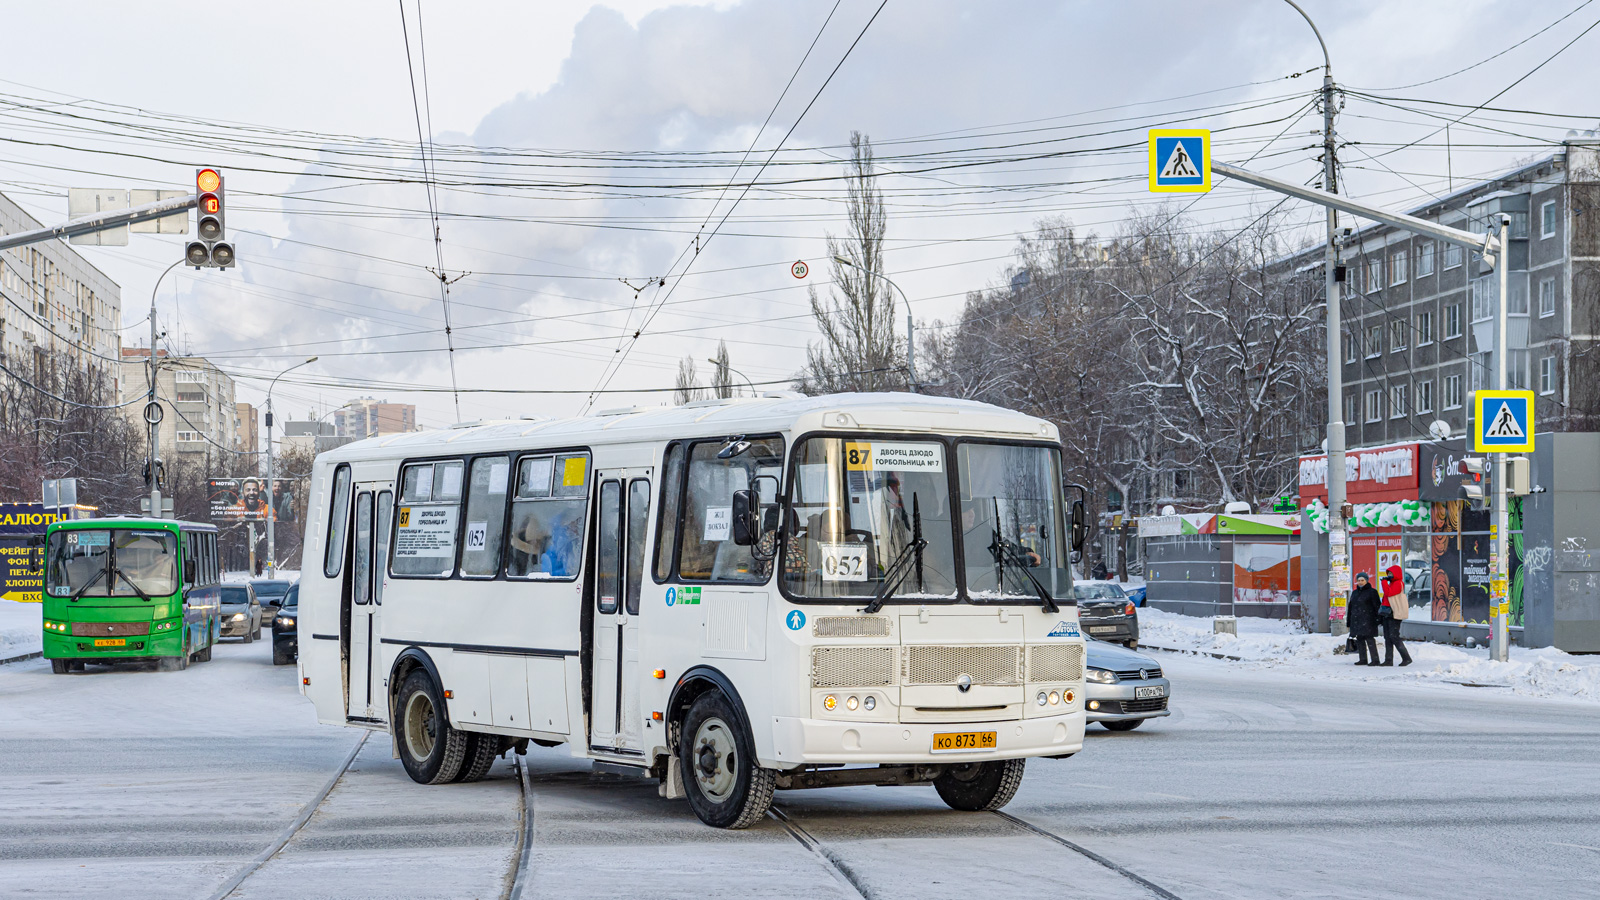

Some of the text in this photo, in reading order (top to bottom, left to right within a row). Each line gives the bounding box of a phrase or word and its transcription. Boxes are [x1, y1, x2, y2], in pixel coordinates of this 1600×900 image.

[795, 266, 805, 274] 20
[848, 449, 870, 465] 87
[400, 512, 410, 525] 87
[67, 534, 78, 543] 83
[468, 530, 485, 546] 052
[826, 555, 863, 575] 052
[57, 587, 68, 595] 83
[938, 733, 993, 748] КО 873 66
